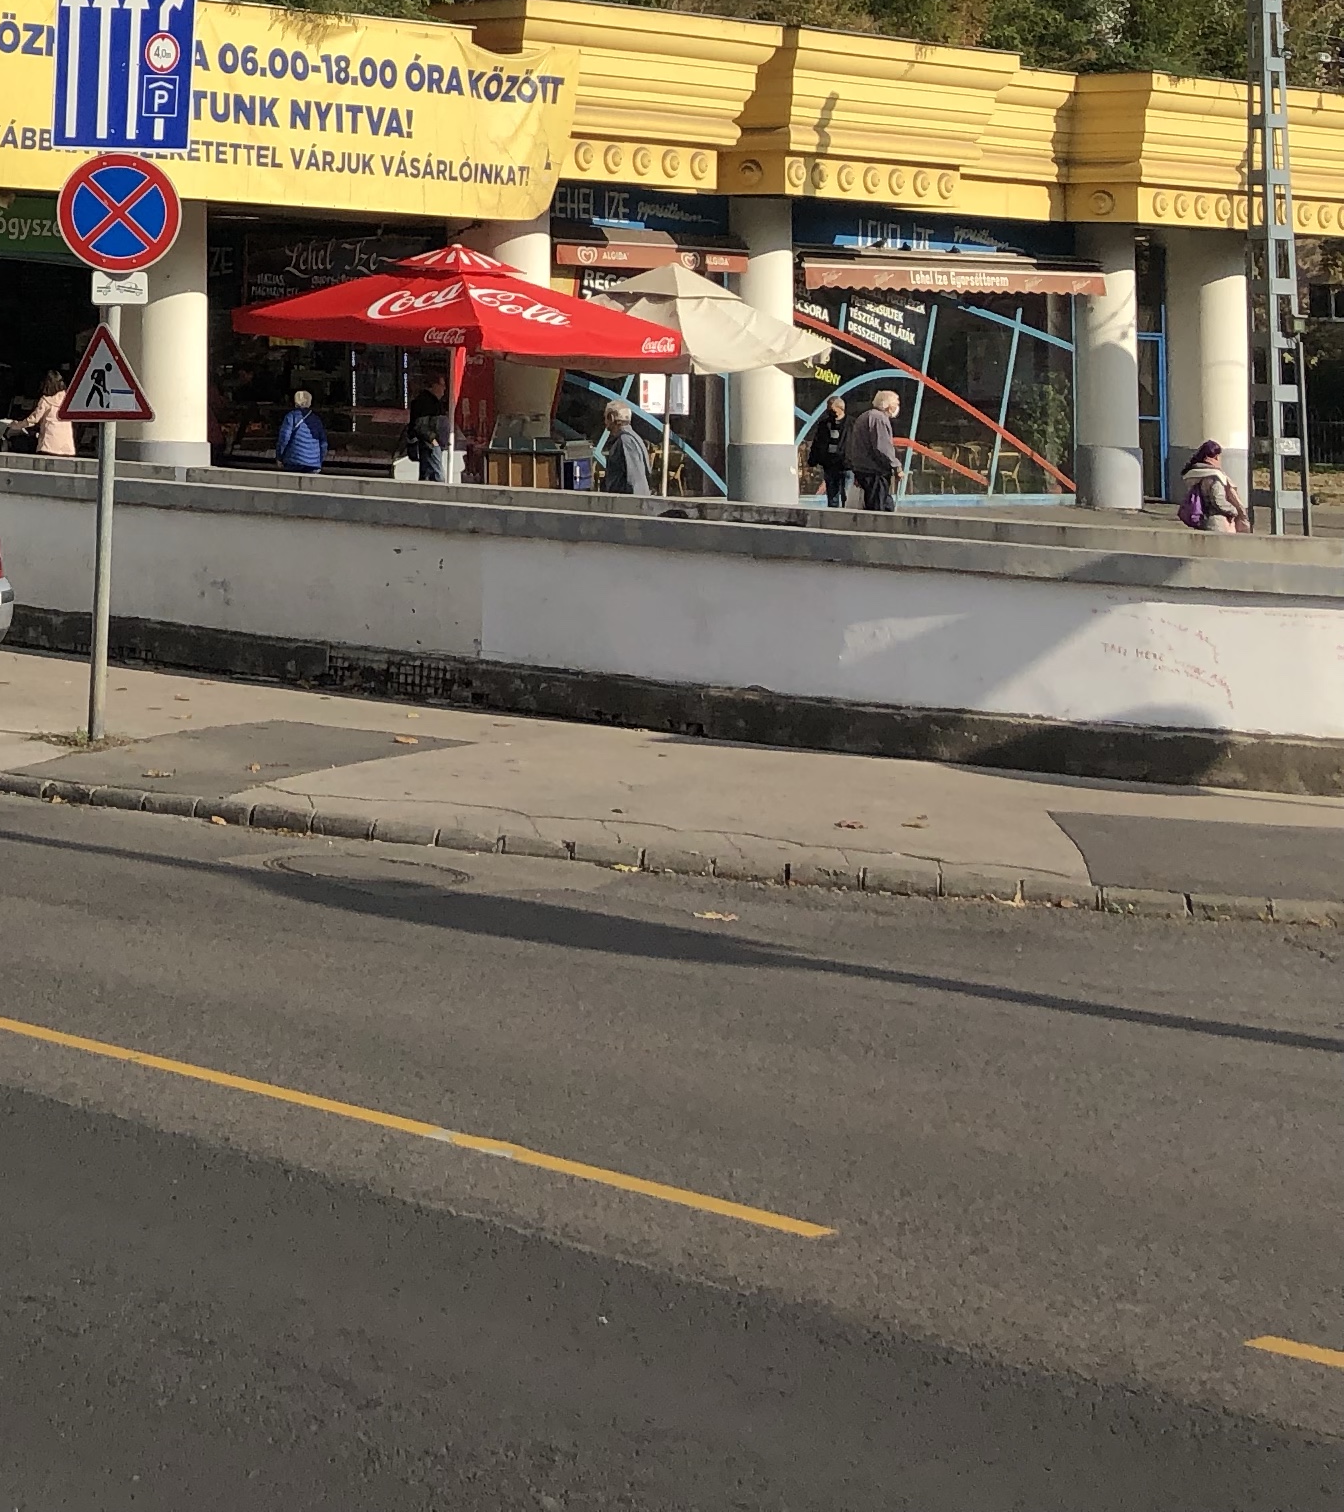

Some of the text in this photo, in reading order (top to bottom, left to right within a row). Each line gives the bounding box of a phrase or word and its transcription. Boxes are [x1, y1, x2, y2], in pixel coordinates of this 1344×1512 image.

[217, 41, 398, 89] 06.00-18.00
[405, 52, 465, 97] ÓRA
[468, 65, 565, 105] KÖZÖTT
[154, 89, 169, 113] P
[289, 100, 414, 139] NYITVA!
[289, 142, 375, 176] VÁRJUK
[380, 149, 530, 187] VÁSÁRLÓINKAT!
[604, 191, 630, 221] IZE
[281, 239, 334, 279] Lehel
[602, 251, 629, 261] ALGIDA
[910, 270, 935, 285] Lehel
[847, 321, 892, 351] DESSZERTEK
[883, 321, 917, 346] SALÁTÁK
